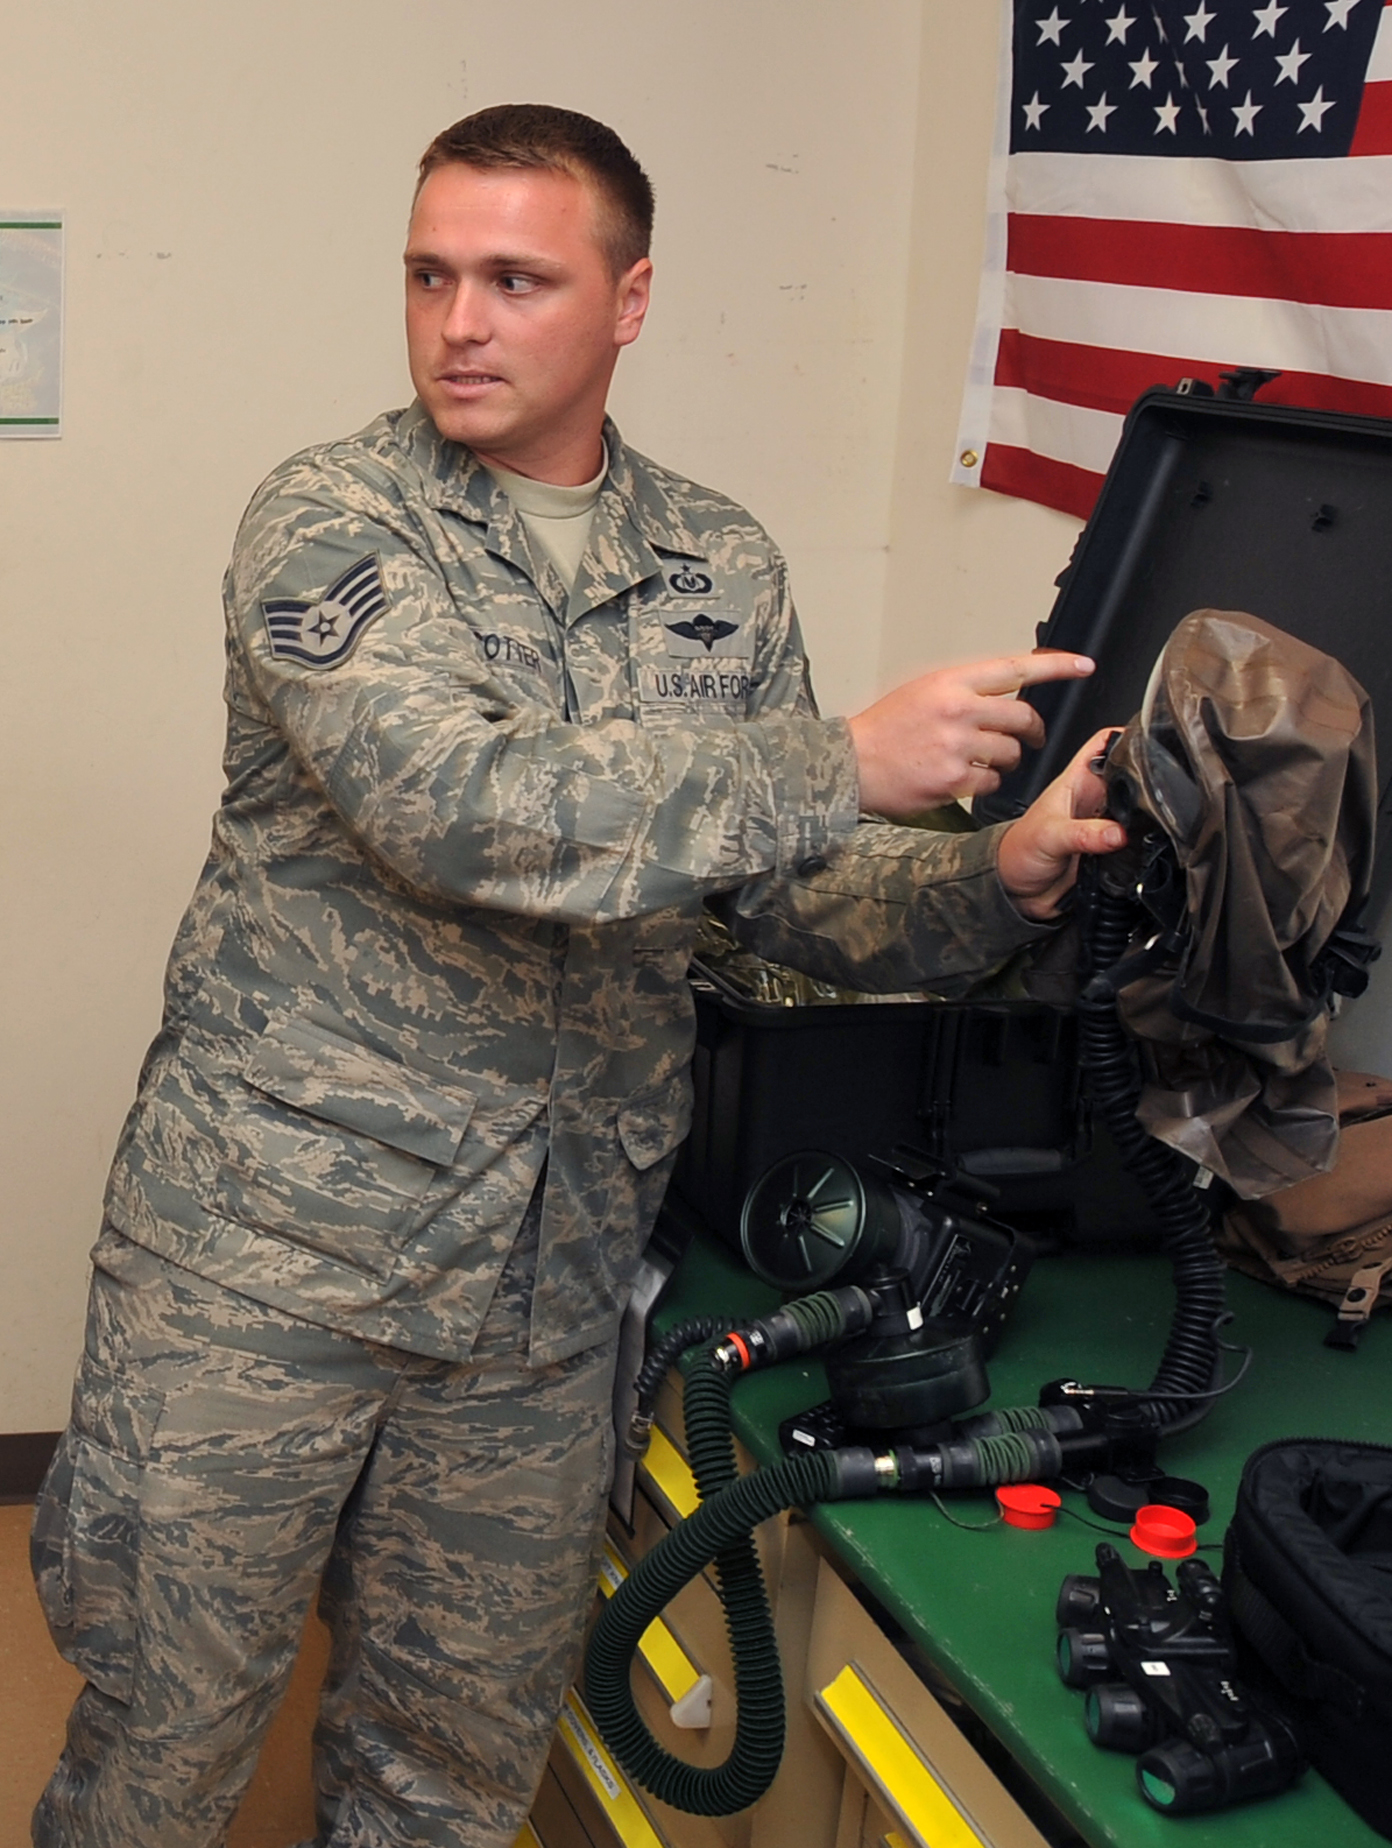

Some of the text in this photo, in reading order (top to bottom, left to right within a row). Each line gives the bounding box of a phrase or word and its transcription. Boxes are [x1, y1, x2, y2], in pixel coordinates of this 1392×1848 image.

[474, 631, 542, 673] OTTER
[655, 673, 752, 699] U.S. AIR FOR
